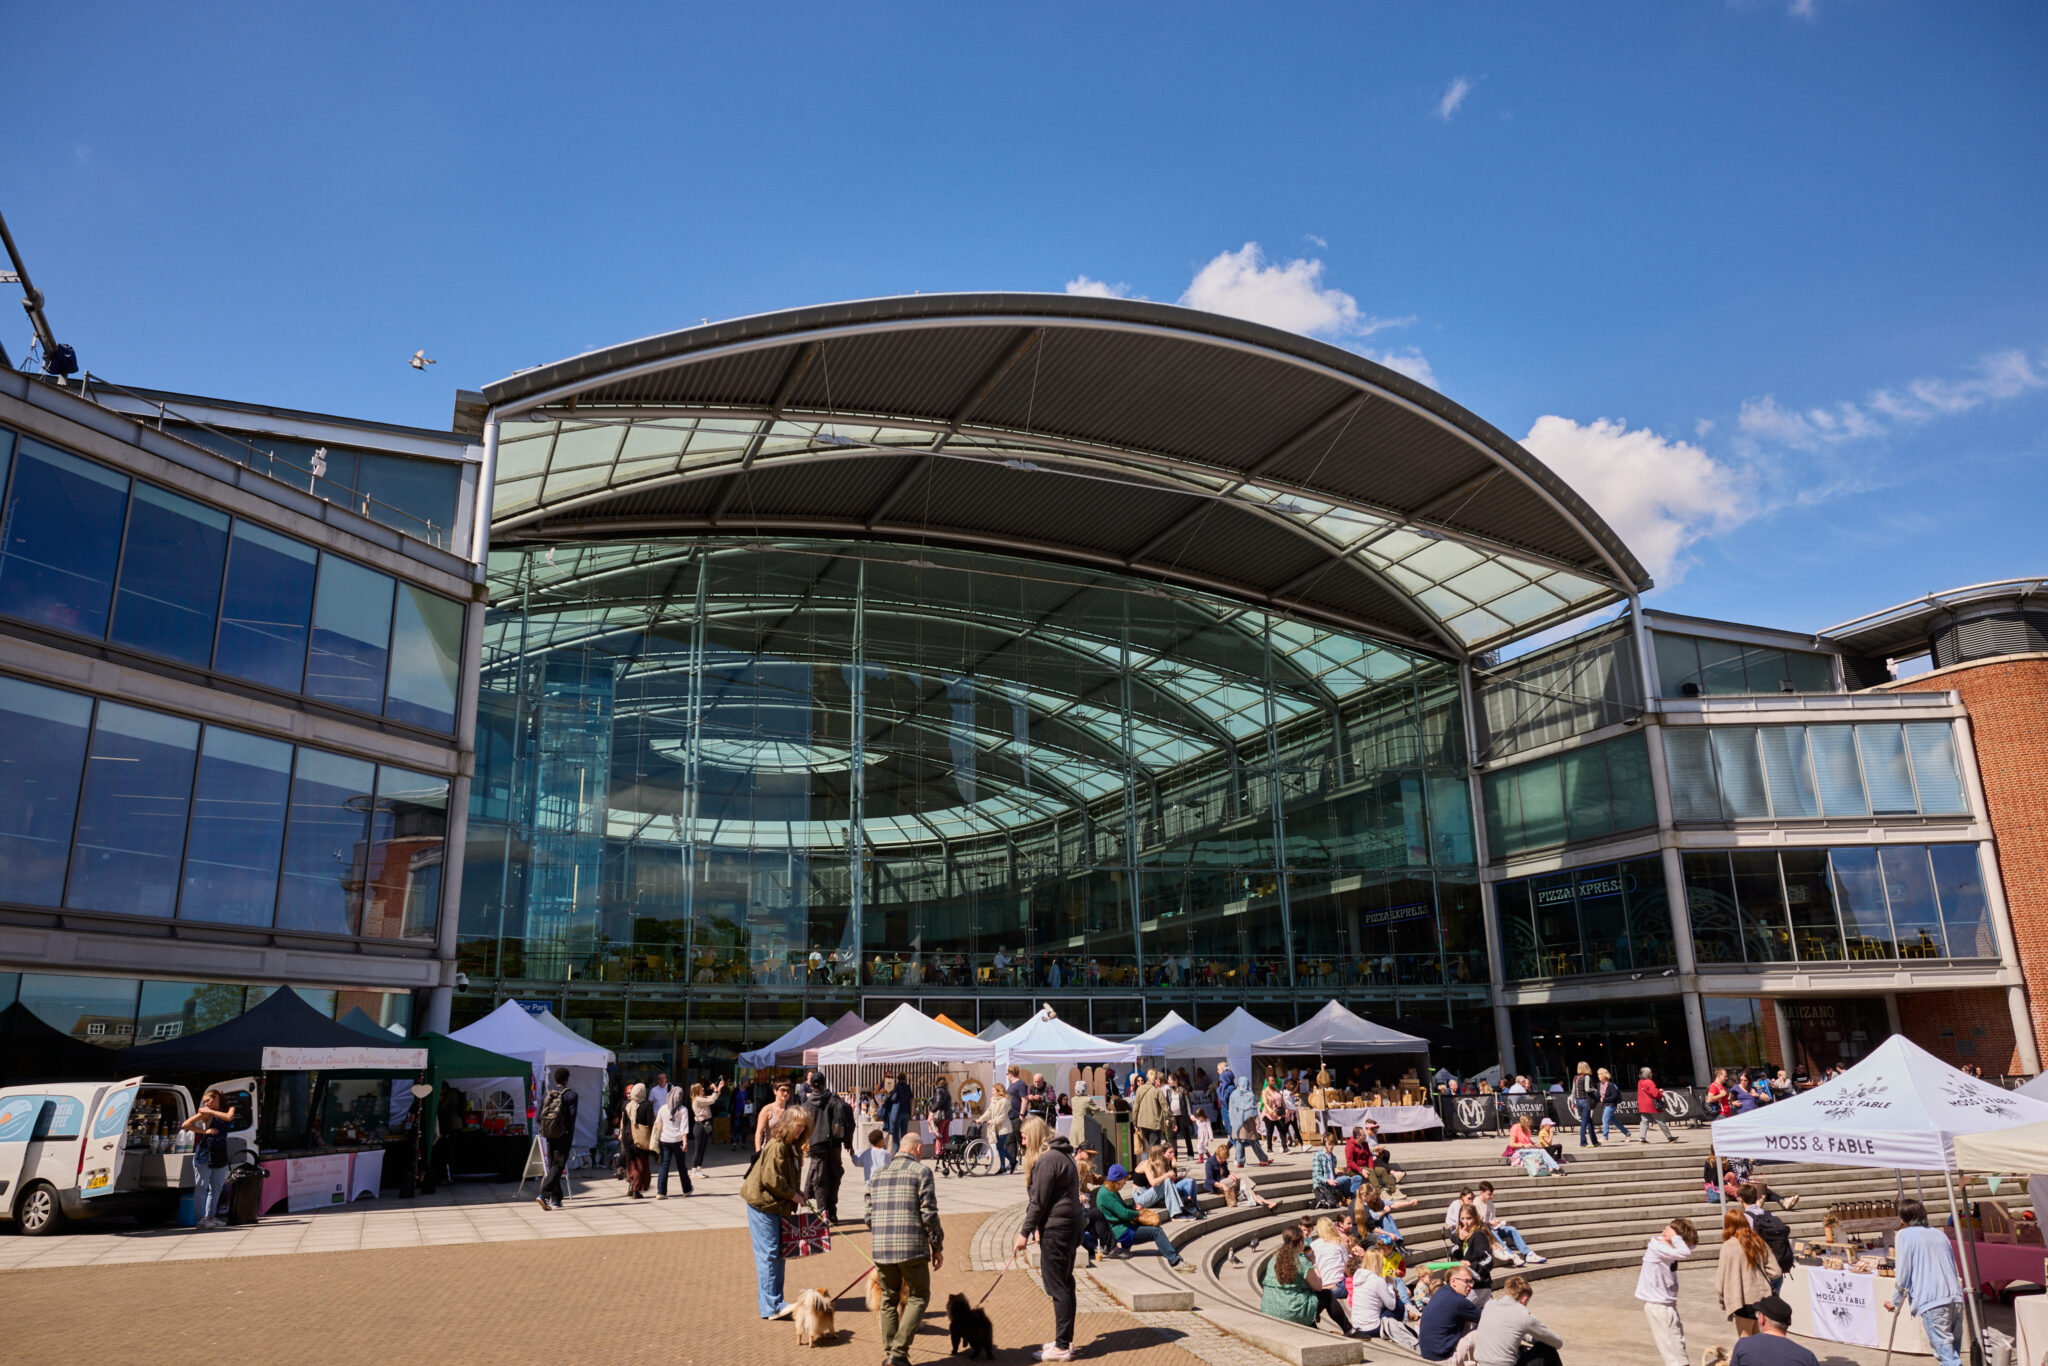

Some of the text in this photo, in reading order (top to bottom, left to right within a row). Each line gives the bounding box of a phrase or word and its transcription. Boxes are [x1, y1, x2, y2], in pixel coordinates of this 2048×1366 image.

[1510, 1103, 1544, 1111] MARZANO
[1858, 1100, 1892, 1109] FABLE
[1765, 1135, 1875, 1154] MOSS & FABLE
[791, 1226, 817, 1238] M&S
[1816, 1293, 1836, 1301] MOSS
[1845, 1296, 1866, 1305] FABLE
